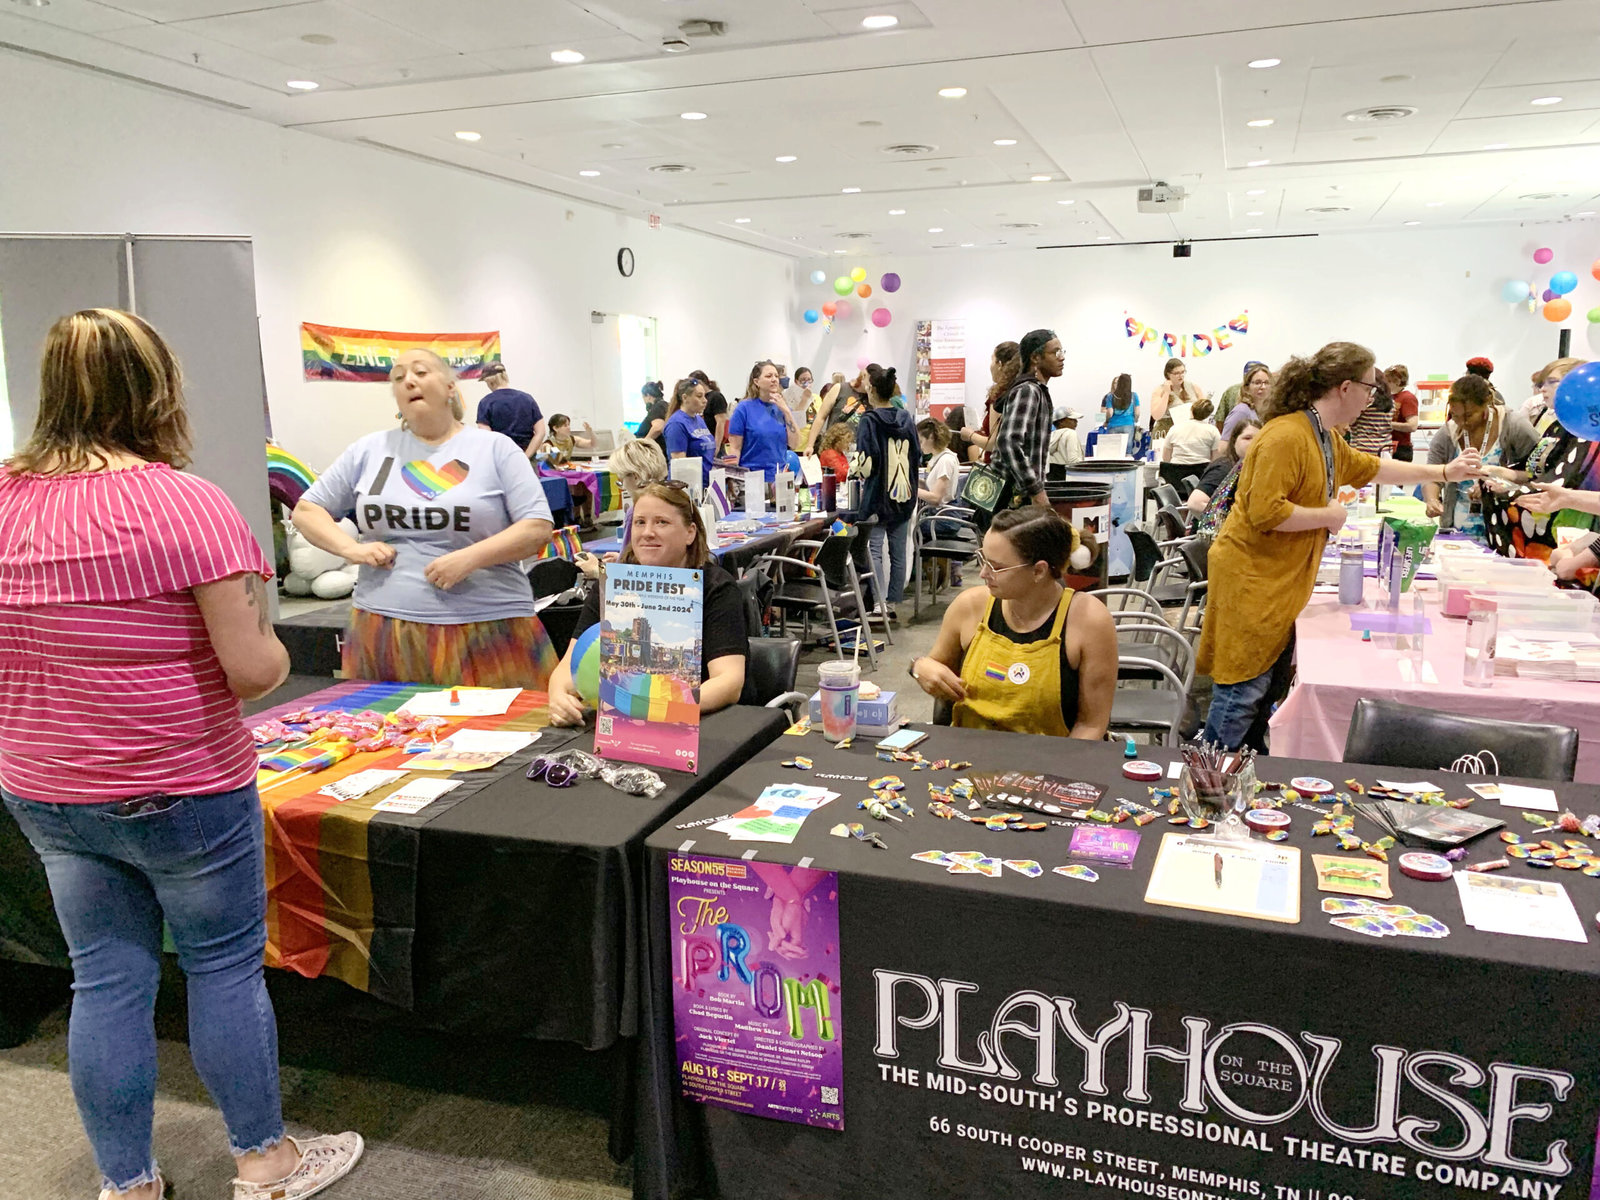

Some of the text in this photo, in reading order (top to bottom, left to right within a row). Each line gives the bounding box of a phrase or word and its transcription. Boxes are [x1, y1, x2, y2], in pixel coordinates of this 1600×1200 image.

[1139, 325, 1233, 357] PRIDE
[364, 504, 471, 532] PRIDE
[627, 571, 673, 580] MEMPHIS
[614, 579, 685, 595] PRIDE FEST
[606, 600, 619, 608] May
[671, 876, 708, 888] Playhouse
[720, 881, 731, 889] the
[733, 883, 759, 892] Square
[677, 896, 730, 935] The
[680, 923, 835, 1041] PROM
[723, 998, 745, 1006] Martin
[689, 1008, 705, 1016] Chad
[699, 1033, 712, 1041] Jack
[735, 1023, 762, 1032] Matthew
[756, 1043, 823, 1059] Daniel Stuart Nelson
[872, 969, 1575, 1177] PLAYHOUSE
[1220, 1054, 1293, 1076] ON THE
[682, 1061, 704, 1076] AUG
[706, 1066, 718, 1079] 18
[727, 1069, 754, 1086] SEPT
[756, 1076, 769, 1089] 17
[1220, 1070, 1293, 1092] SQUARE
[822, 1112, 840, 1121] ARTS
[878, 1063, 1562, 1200] THE MID-SOUTH'S PROFESSIONAL THEATRE COMPANY
[929, 1116, 951, 1134] 66
[956, 1123, 1013, 1148] SOUTH
[1018, 1135, 1087, 1161] COOPER
[1092, 1150, 1165, 1181] STREET,
[1172, 1164, 1266, 1200] MEMPHIS,
[1274, 1185, 1300, 1200] TN
